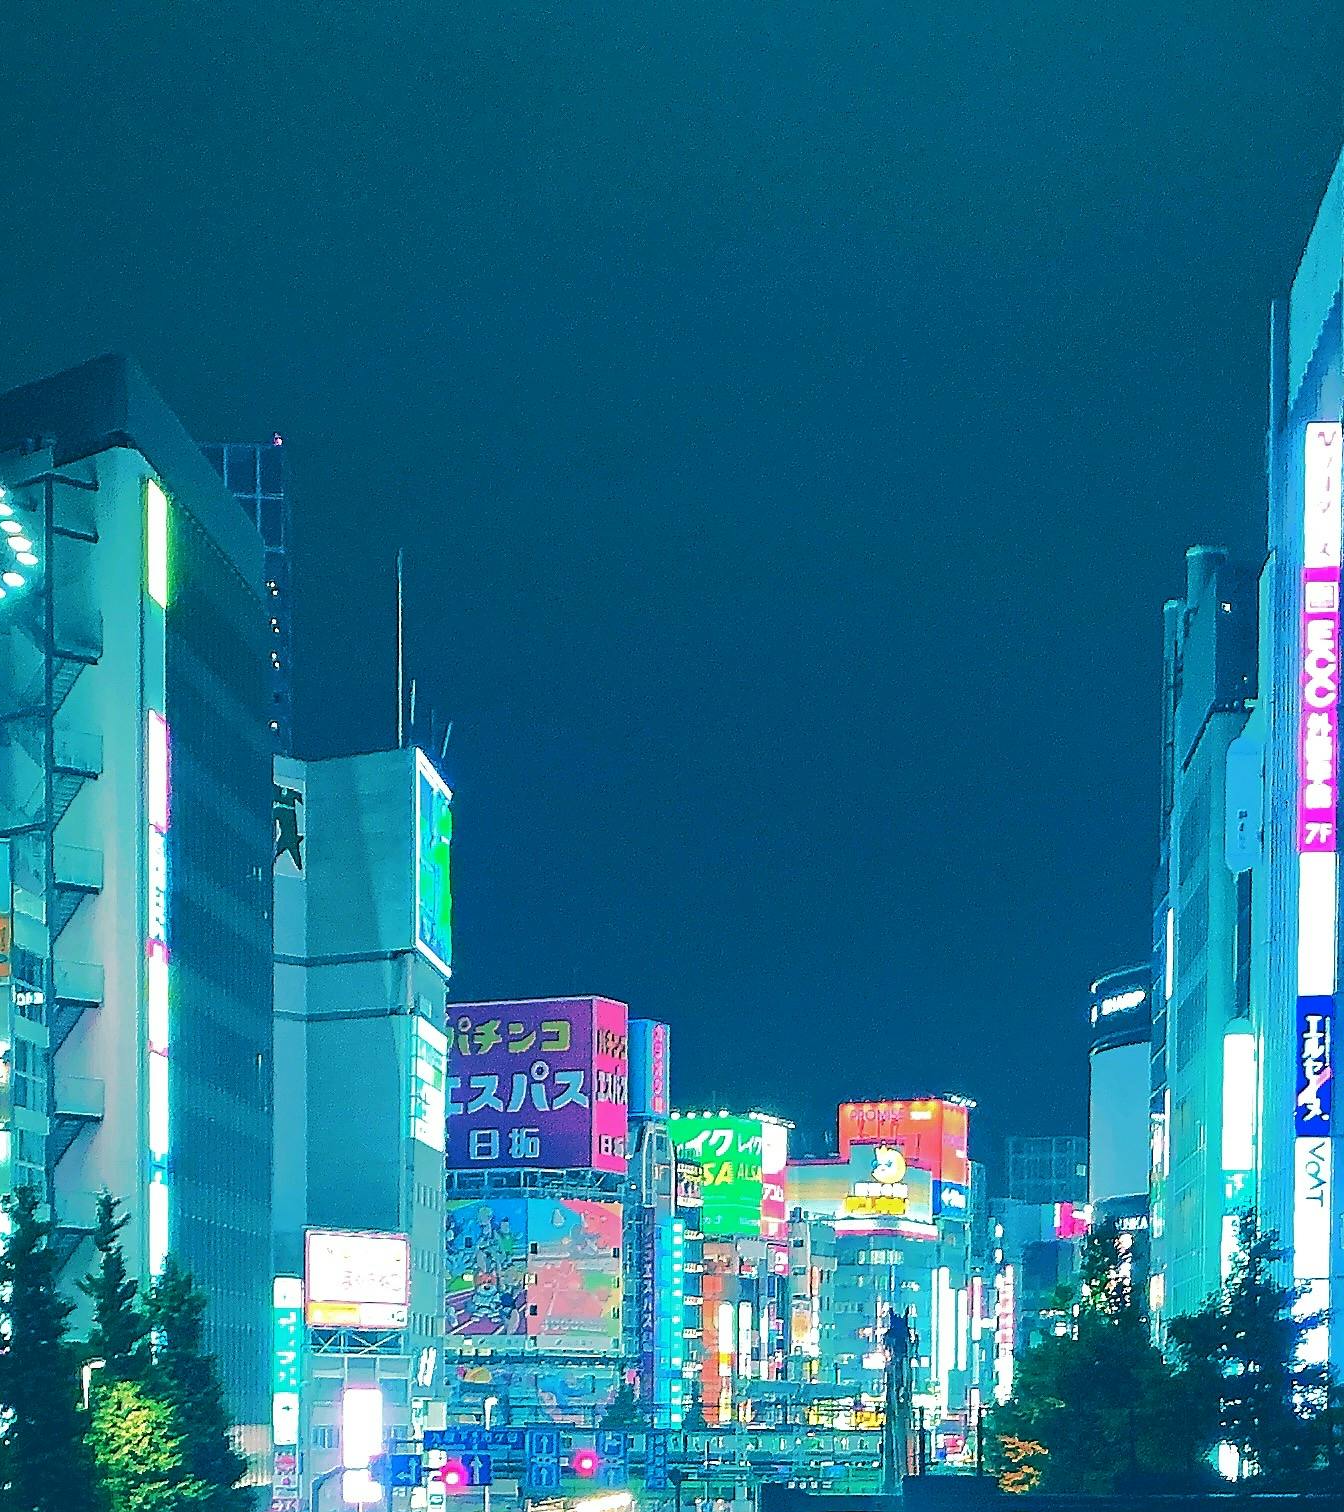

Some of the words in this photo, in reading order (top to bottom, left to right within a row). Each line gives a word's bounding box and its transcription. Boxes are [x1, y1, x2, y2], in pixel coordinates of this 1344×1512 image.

[1304, 822, 1333, 845] 7F
[446, 1061, 589, 1115] エスパス
[469, 1127, 540, 1161] 日拓
